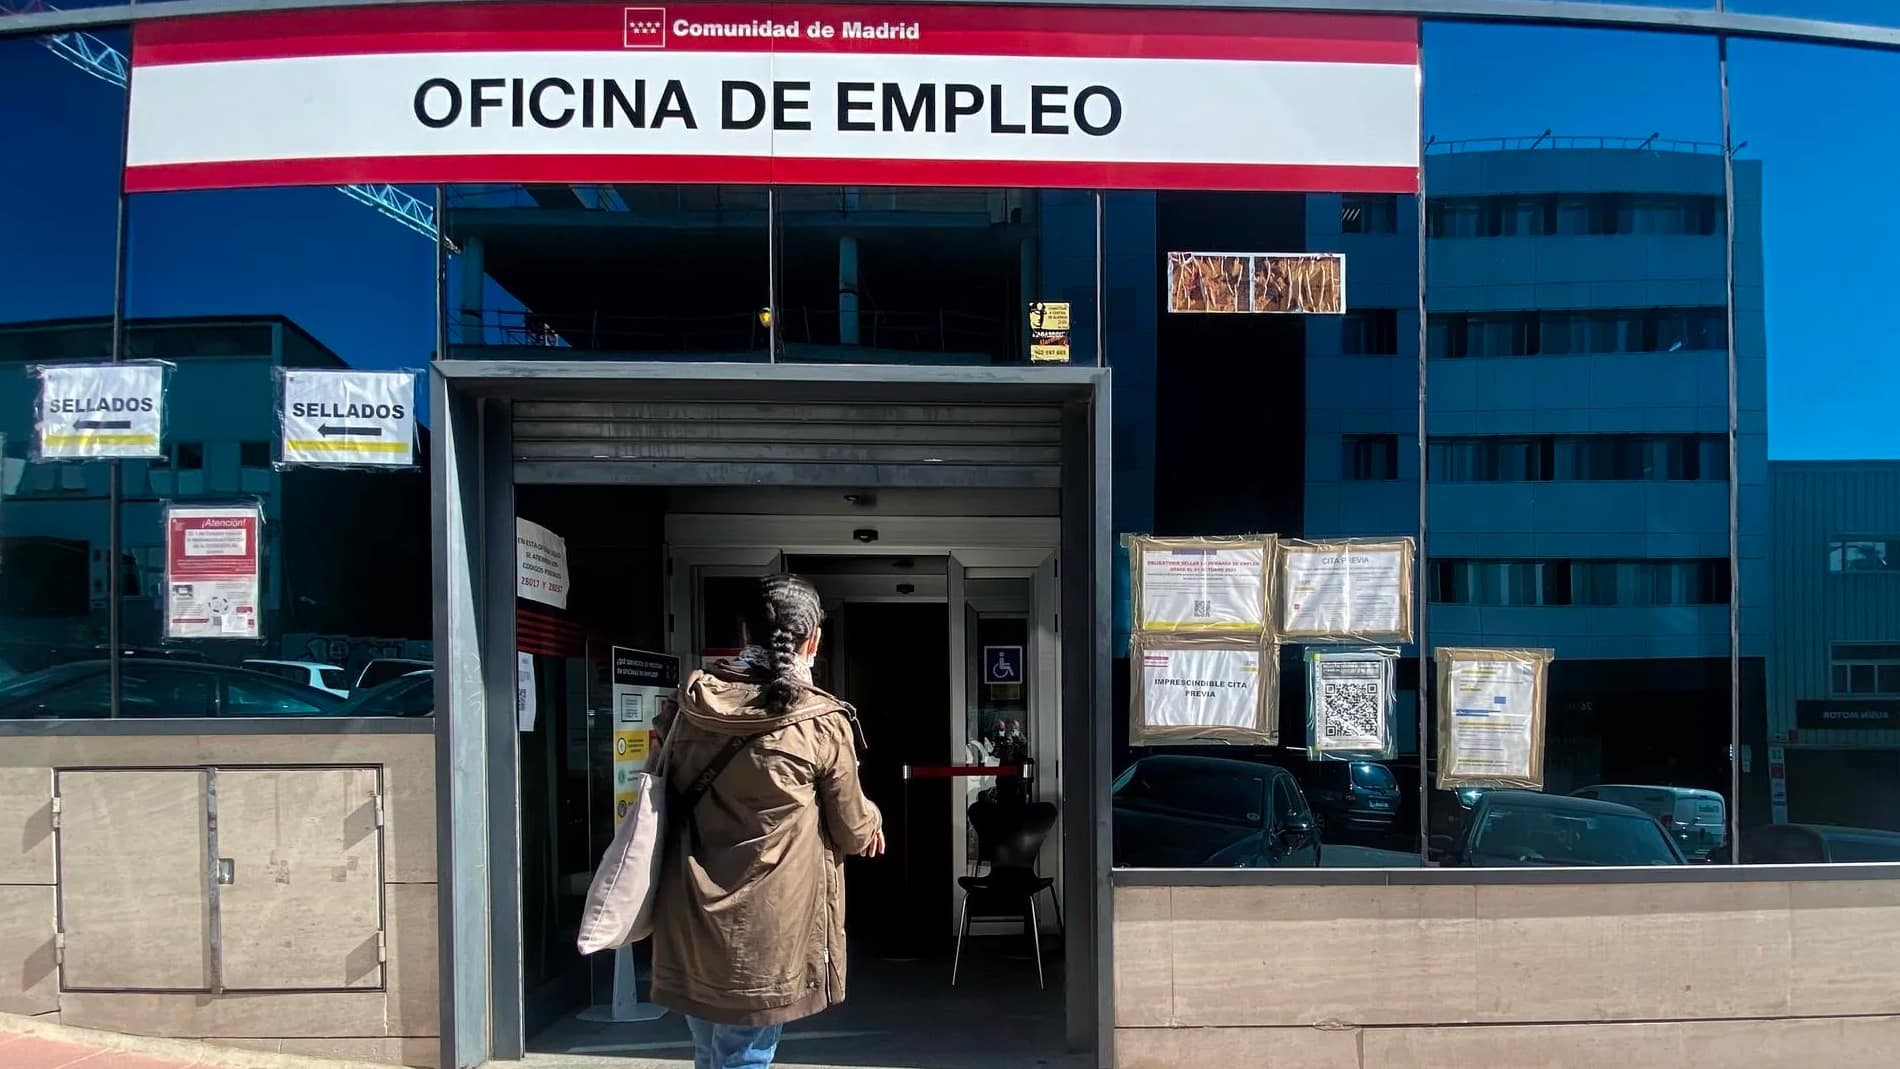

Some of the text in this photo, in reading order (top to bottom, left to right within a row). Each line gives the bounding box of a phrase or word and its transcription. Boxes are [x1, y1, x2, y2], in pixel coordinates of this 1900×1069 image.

[672, 19, 920, 40] Comunidad de Madrid
[413, 77, 1122, 137] OFICINA DE EMPLEO
[50, 397, 153, 413] SELLADOS
[292, 402, 405, 420] SELLADOS
[201, 518, 247, 529] ¡Atención!
[1321, 557, 1340, 565] CITA
[521, 576, 540, 588] 28017
[1154, 678, 1248, 689] IMPRESCINDIBLE CITA
[1185, 690, 1216, 698] PREVIA
